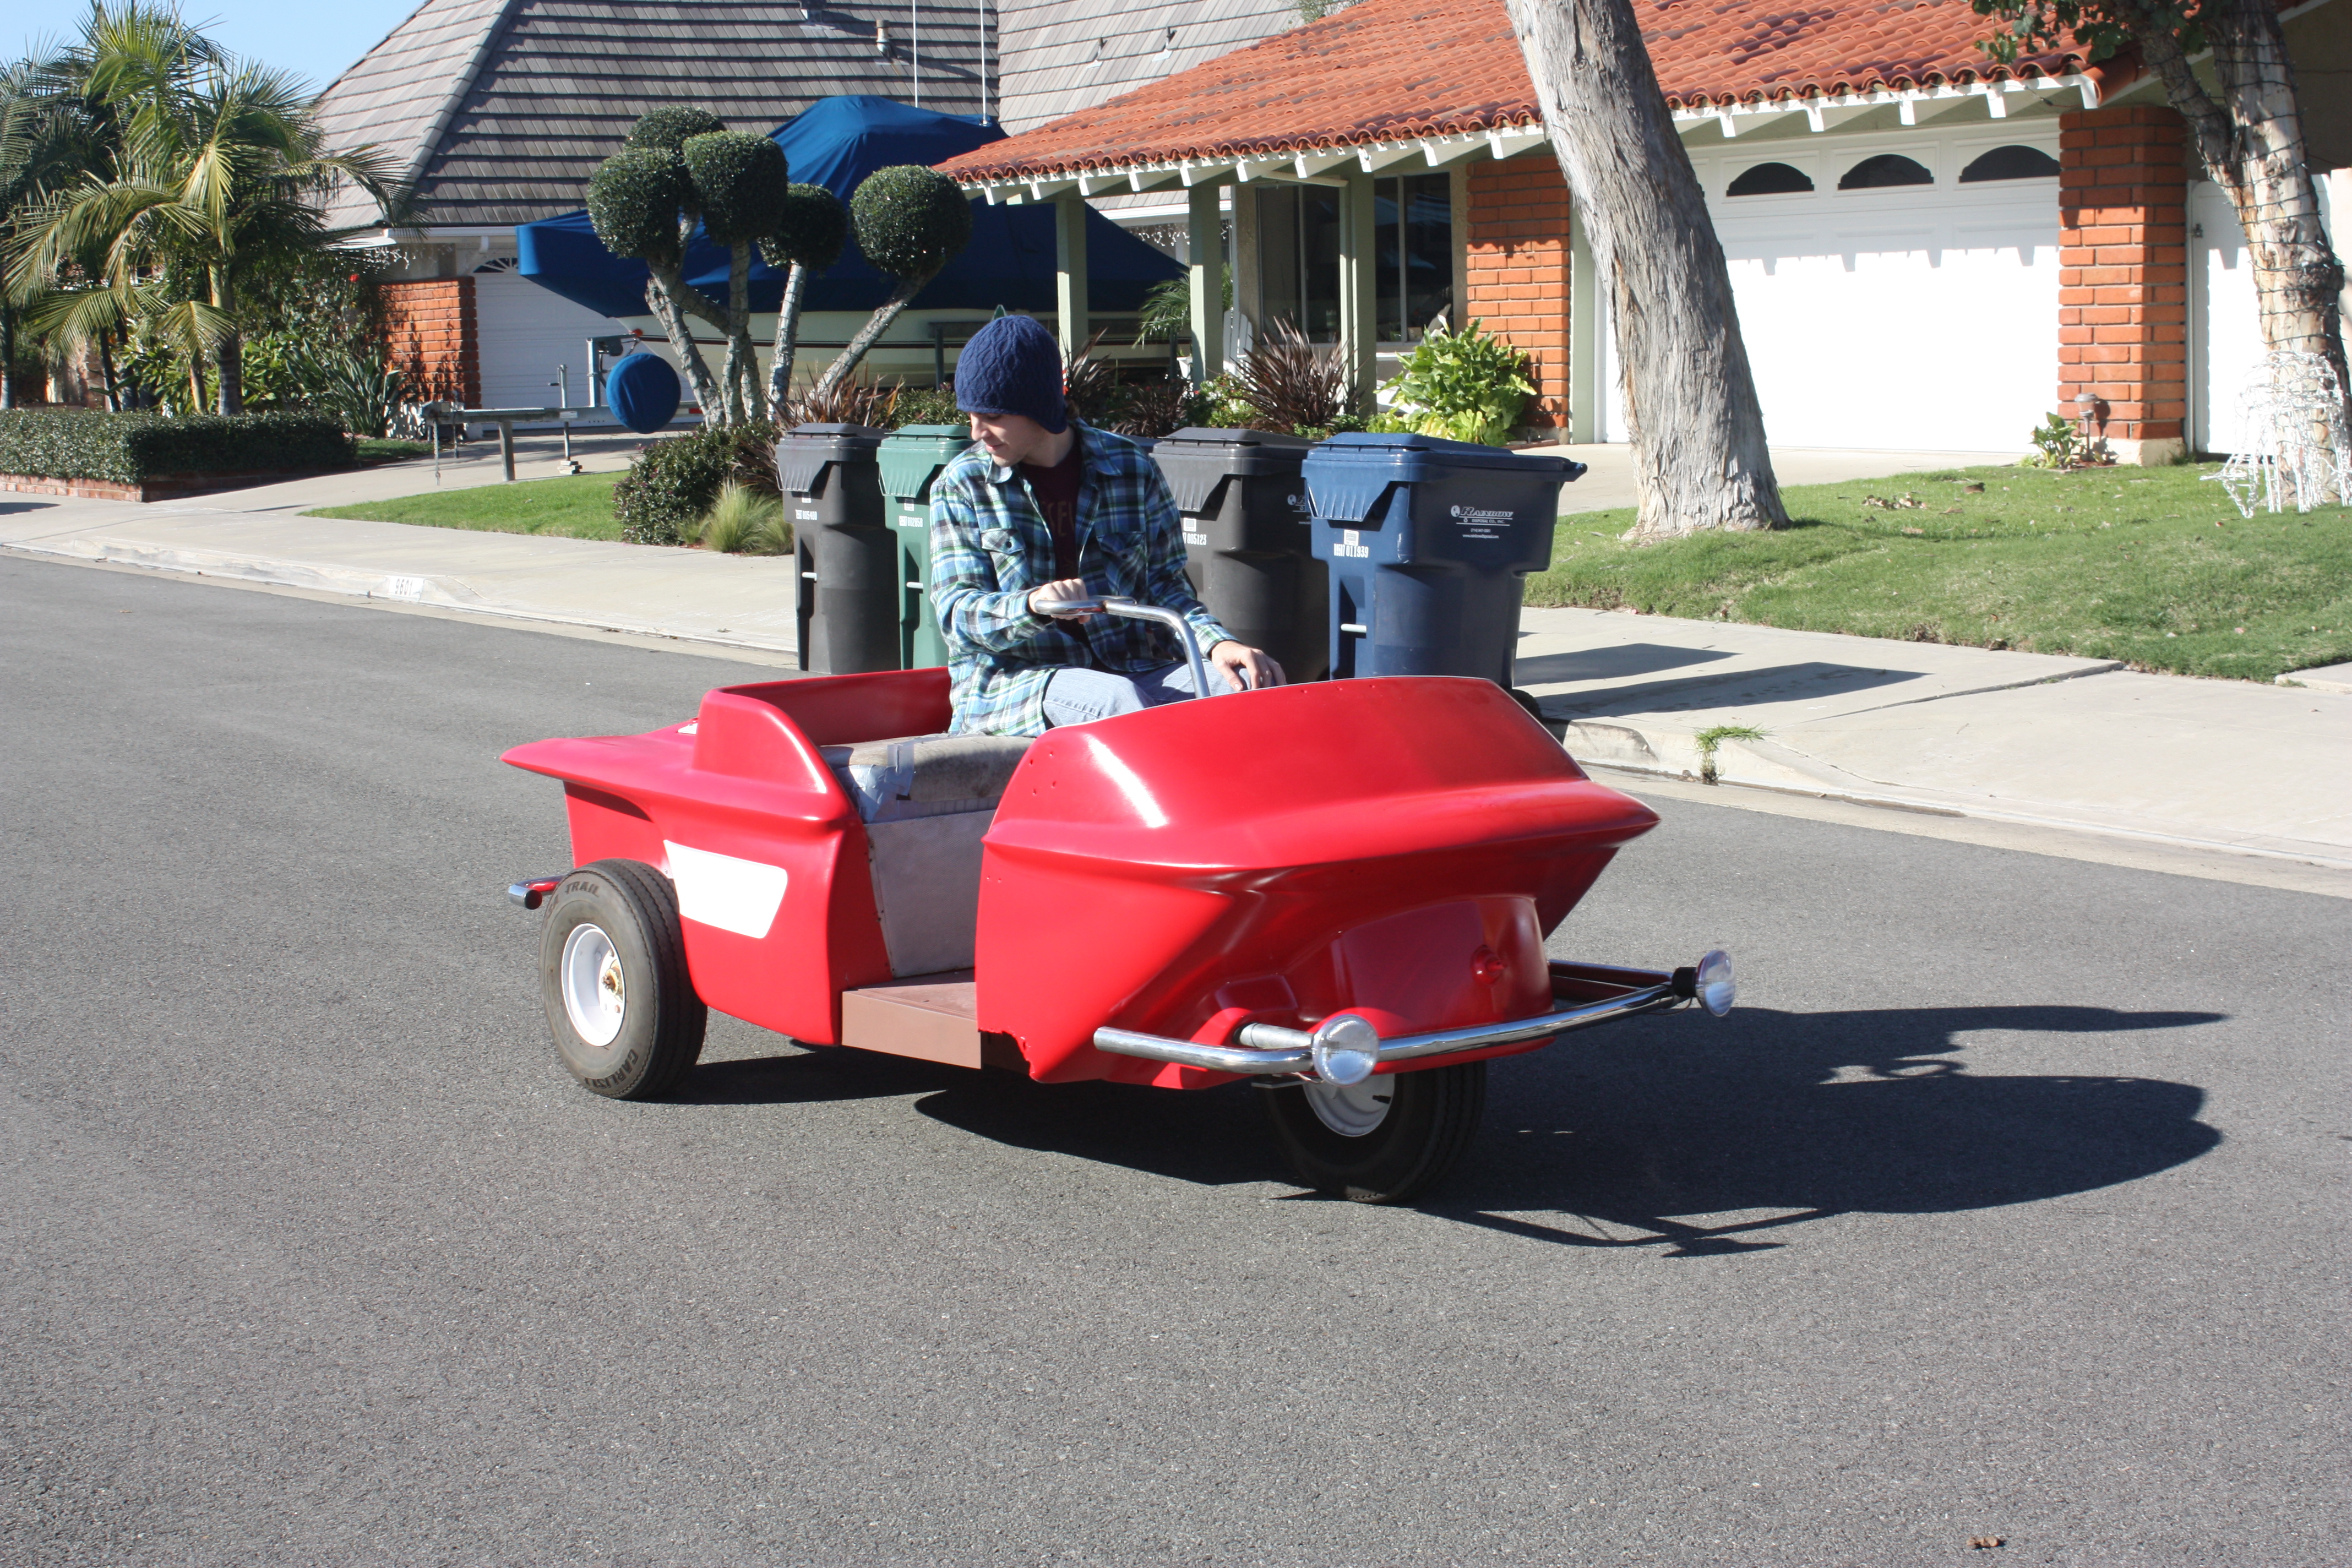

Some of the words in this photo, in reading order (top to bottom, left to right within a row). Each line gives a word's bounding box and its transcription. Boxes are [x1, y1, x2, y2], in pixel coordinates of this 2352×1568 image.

[1460, 506, 1513, 517] RAINBOW
[1187, 533, 1207, 545] 005123
[1346, 545, 1369, 558] 011939
[395, 578, 413, 596] 9601
[564, 881, 600, 899] TRAIL
